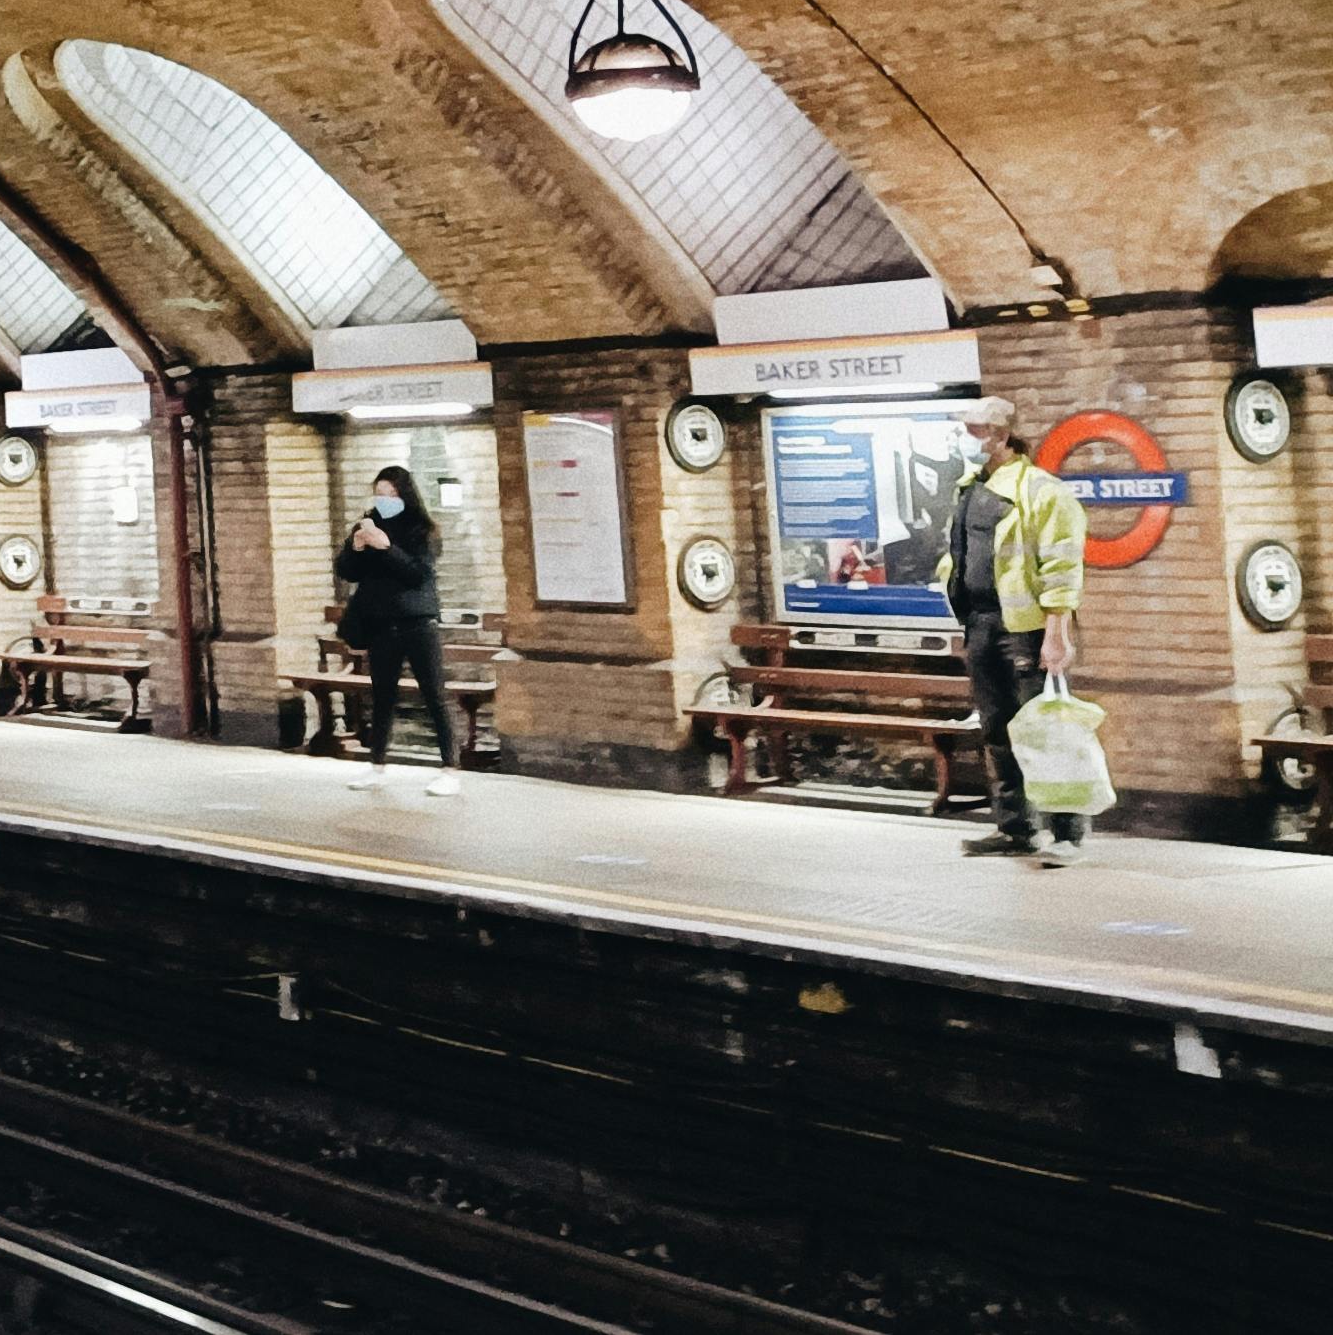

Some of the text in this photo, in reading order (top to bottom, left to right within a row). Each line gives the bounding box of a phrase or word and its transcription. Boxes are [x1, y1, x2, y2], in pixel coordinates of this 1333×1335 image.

[755, 354, 904, 382] BAKER STREET
[1099, 478, 1175, 498] STREET
